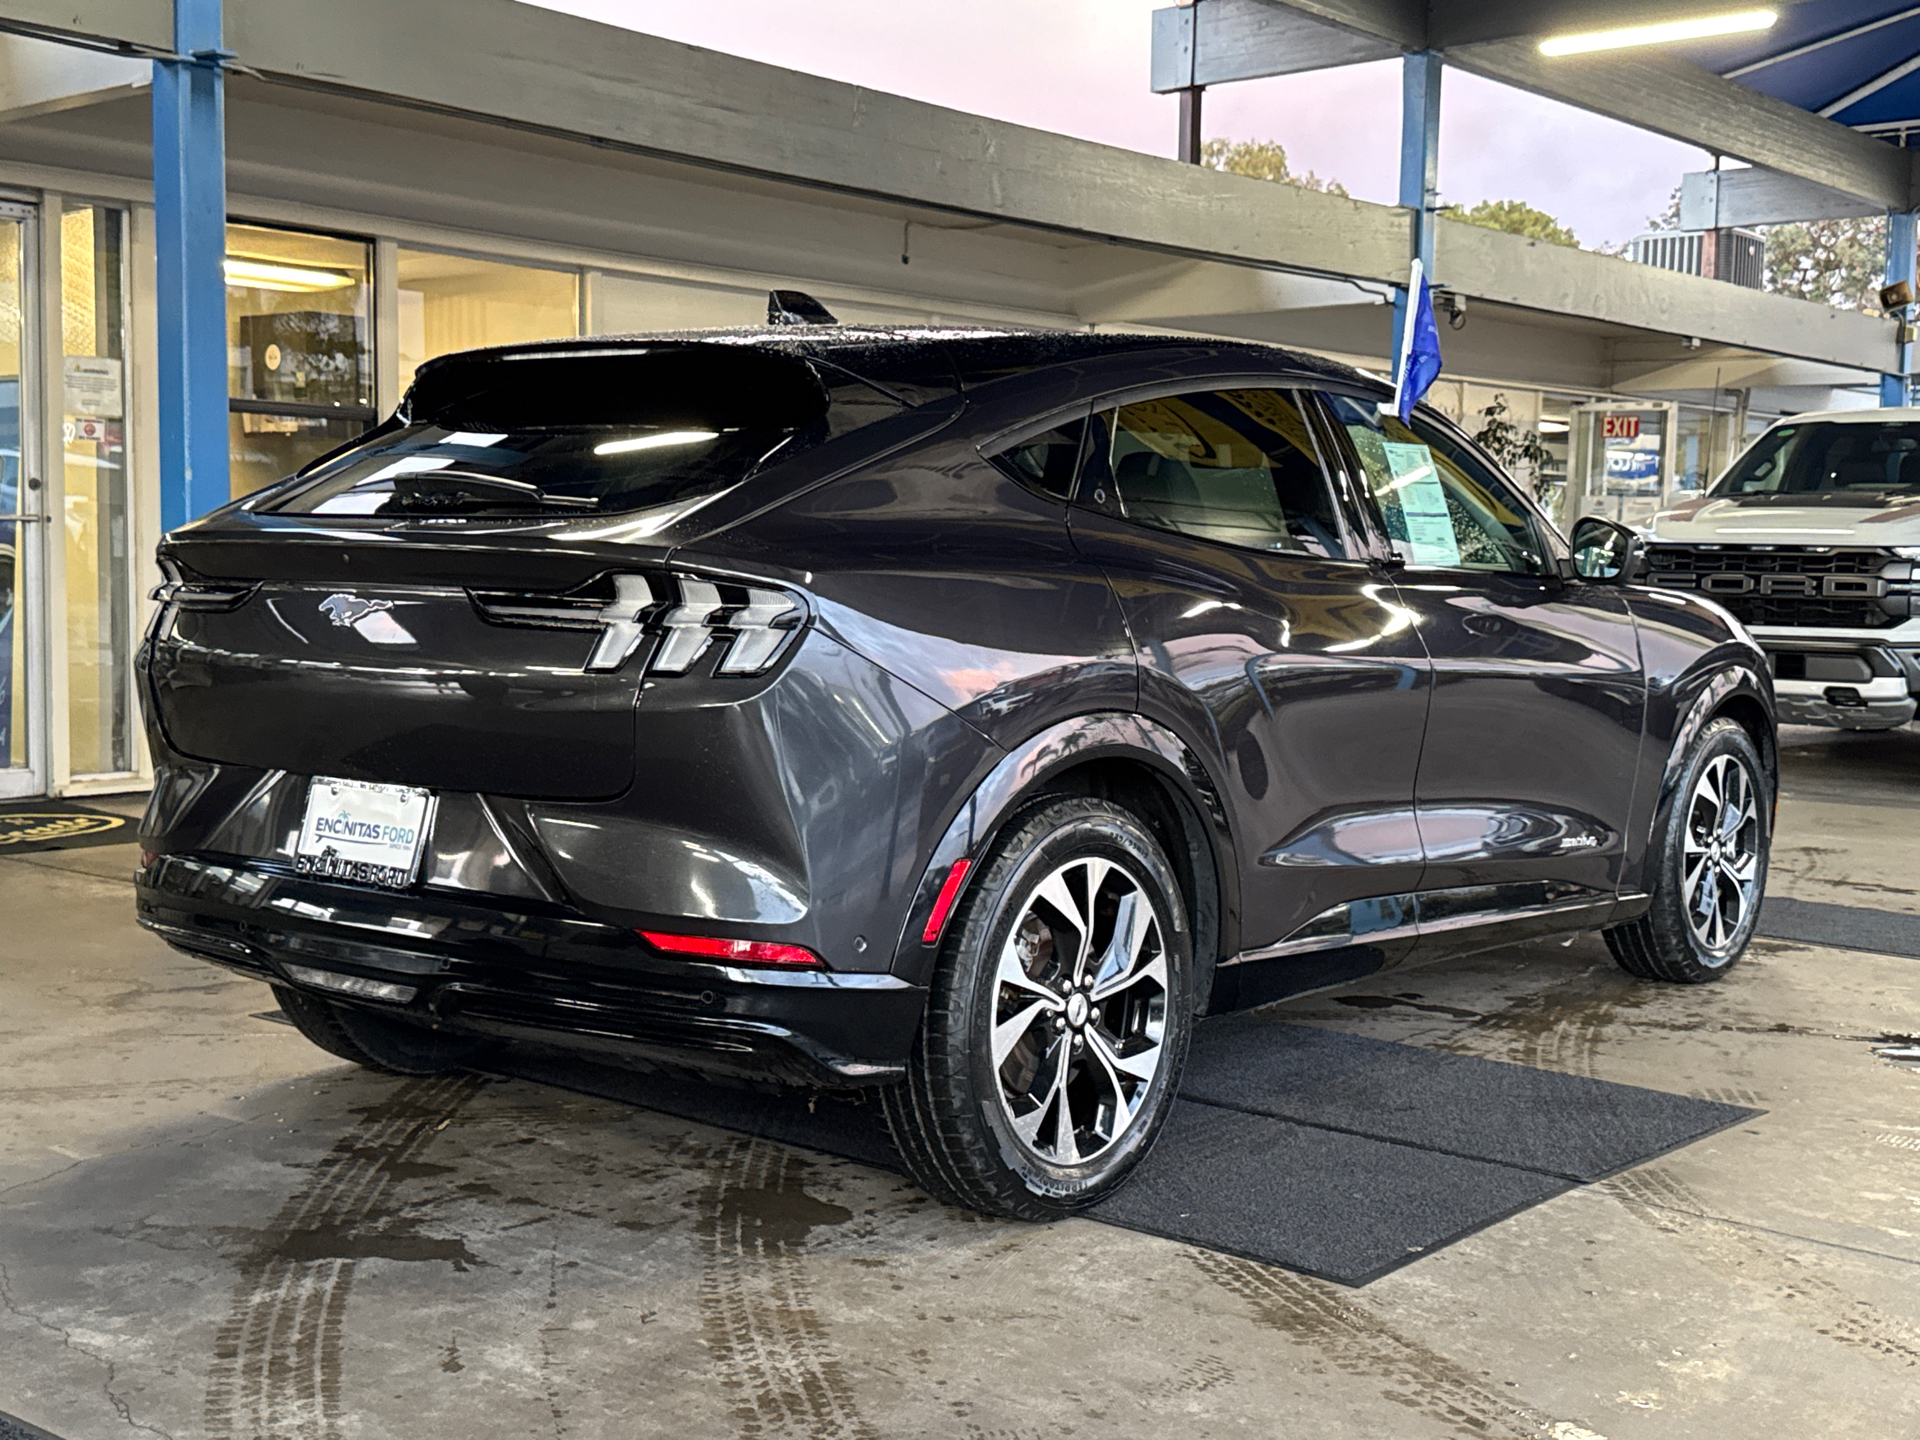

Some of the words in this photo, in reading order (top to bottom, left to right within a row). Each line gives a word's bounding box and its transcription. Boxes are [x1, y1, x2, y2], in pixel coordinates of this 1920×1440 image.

[1602, 417, 1638, 437] EXIT
[1647, 572, 1888, 597] FORD
[315, 817, 381, 839] ENCINITAS
[381, 826, 415, 844] FORD
